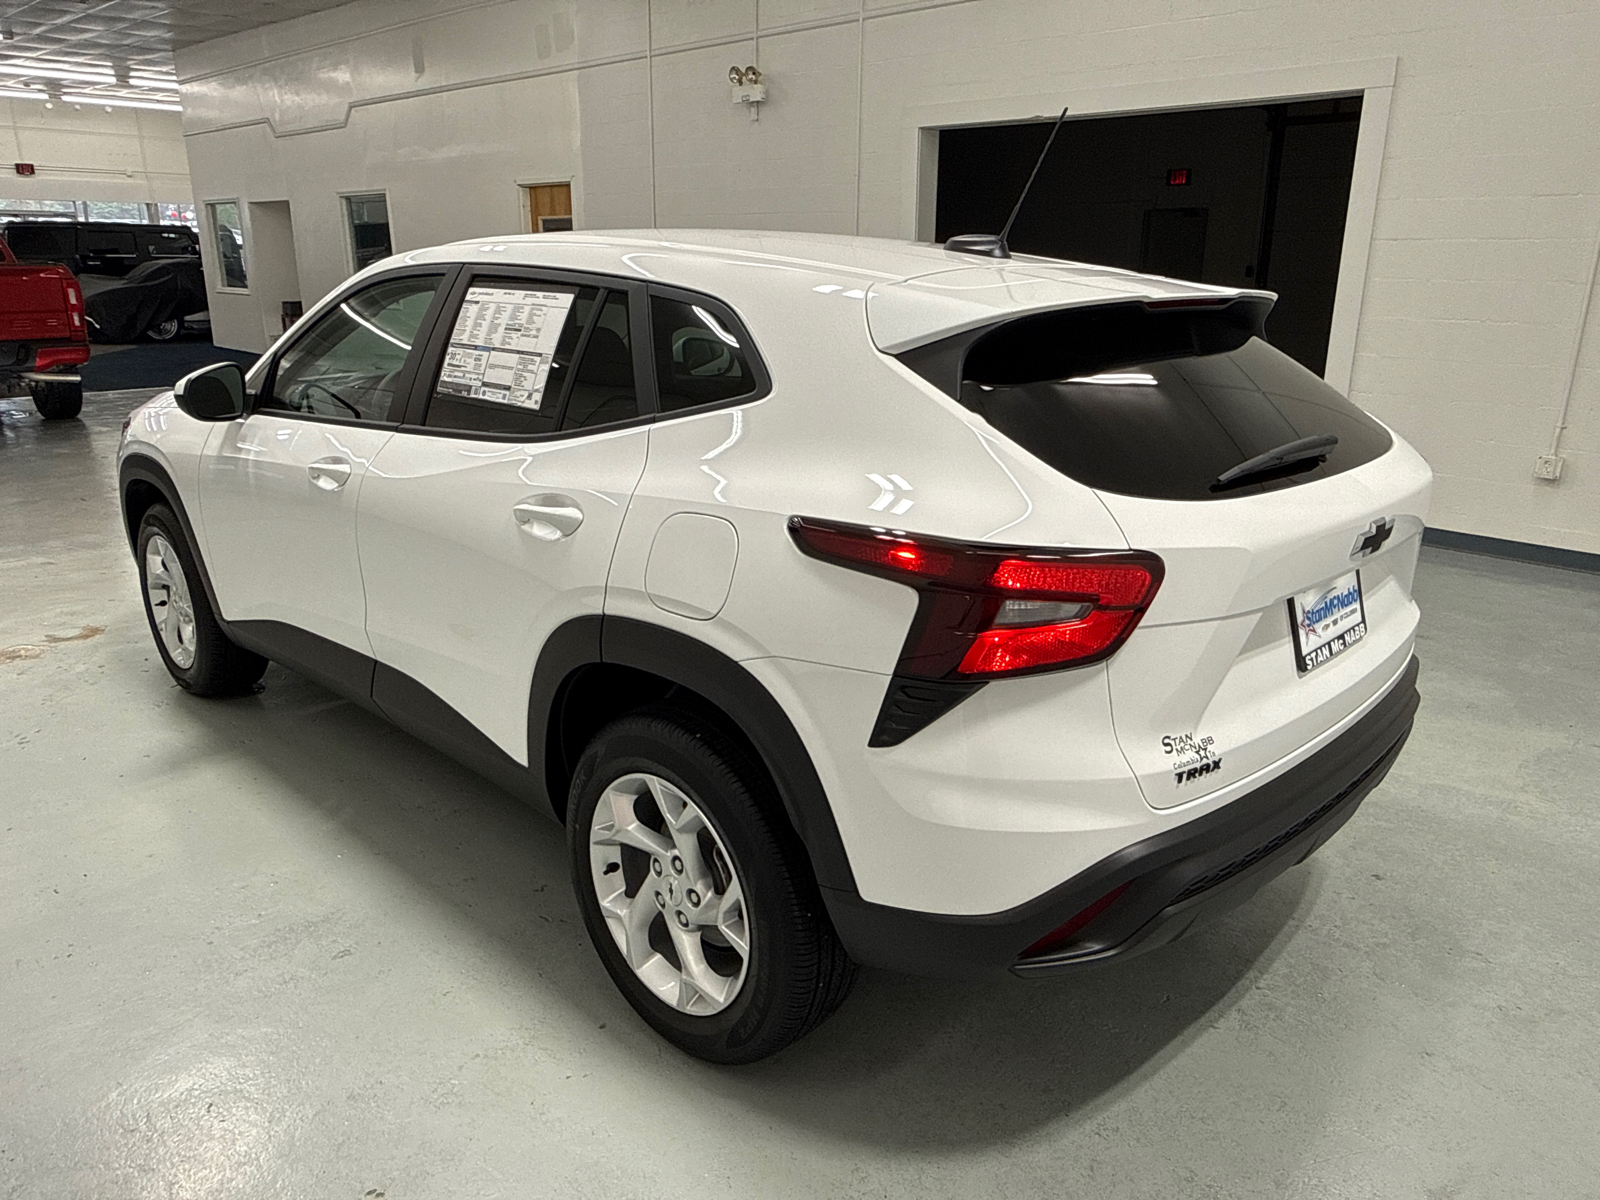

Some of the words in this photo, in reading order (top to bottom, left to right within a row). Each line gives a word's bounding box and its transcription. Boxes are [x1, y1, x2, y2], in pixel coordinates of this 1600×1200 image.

[1305, 645, 1330, 670] STAN
[1344, 623, 1366, 646] NABB
[1161, 732, 1193, 755] STAN
[1175, 757, 1222, 785] TRAX
